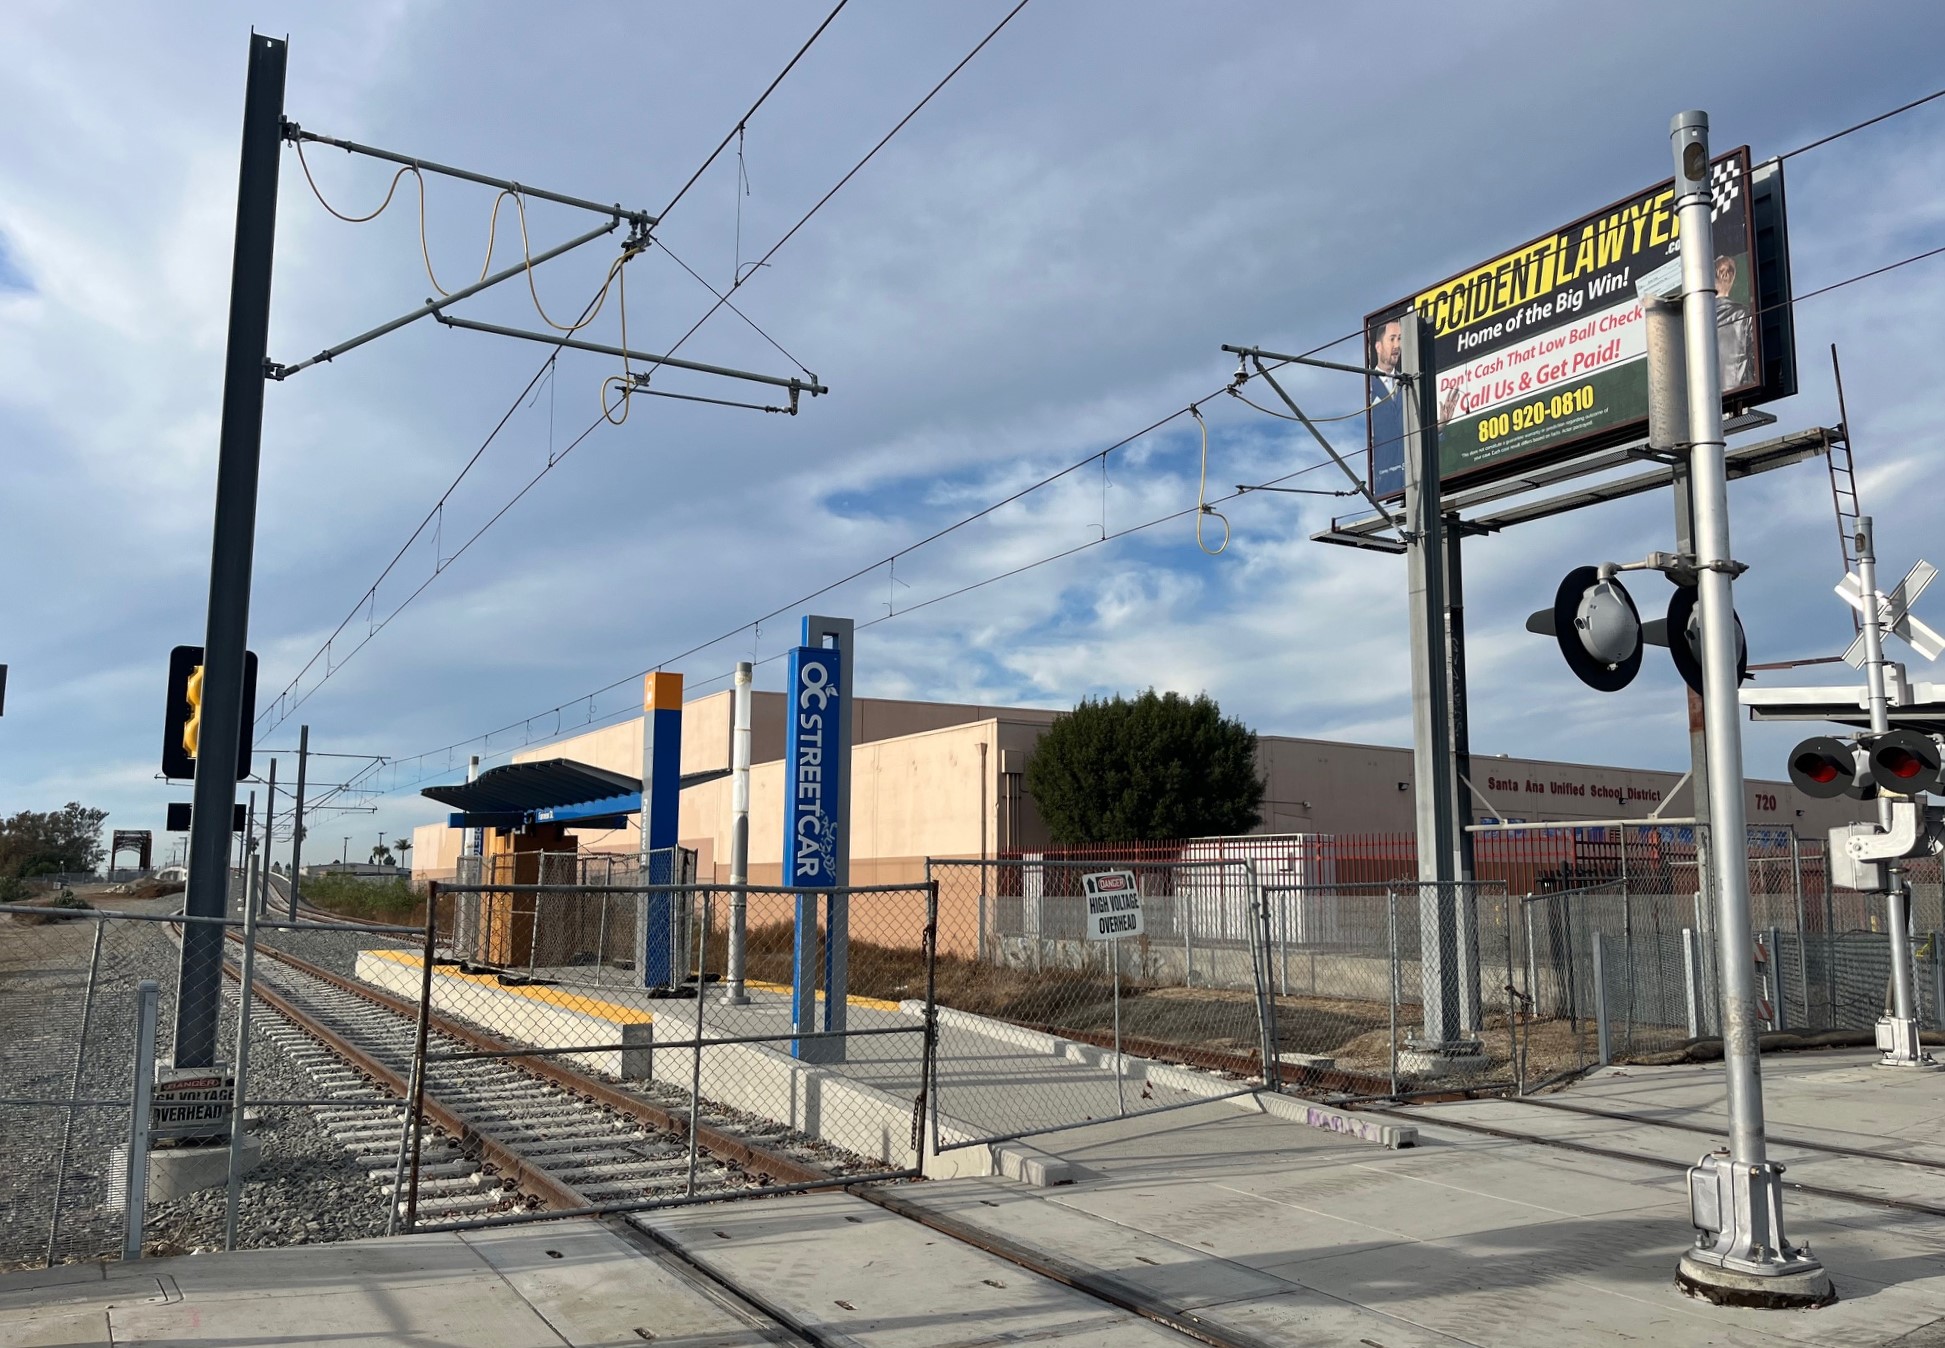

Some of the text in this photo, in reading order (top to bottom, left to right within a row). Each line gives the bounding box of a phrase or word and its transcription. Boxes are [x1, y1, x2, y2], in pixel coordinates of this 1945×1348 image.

[1556, 189, 1680, 286] LAWYE
[1665, 239, 1680, 255] .co
[1457, 322, 1502, 352] Home
[1505, 308, 1524, 332] of
[1525, 303, 1552, 325] the
[1556, 288, 1584, 313] Big
[1588, 266, 1629, 300] Win!
[1440, 369, 1472, 392] Don't
[1475, 357, 1503, 379] Cash
[1507, 346, 1536, 367] That
[1539, 337, 1566, 356] Low
[1569, 320, 1596, 344] Ball
[1460, 338, 1621, 412] Call Us & Get Paid!
[1478, 384, 1594, 443] 800 920-0810
[797, 661, 828, 877] OC STREETCAR
[1488, 776, 1661, 801] Santa Ana Unified School District
[1755, 793, 1777, 811] 720
[1089, 893, 1139, 914] HIGH VOLTAGE
[1099, 879, 1124, 888] DANGER
[1099, 913, 1137, 934] OVERHEAD
